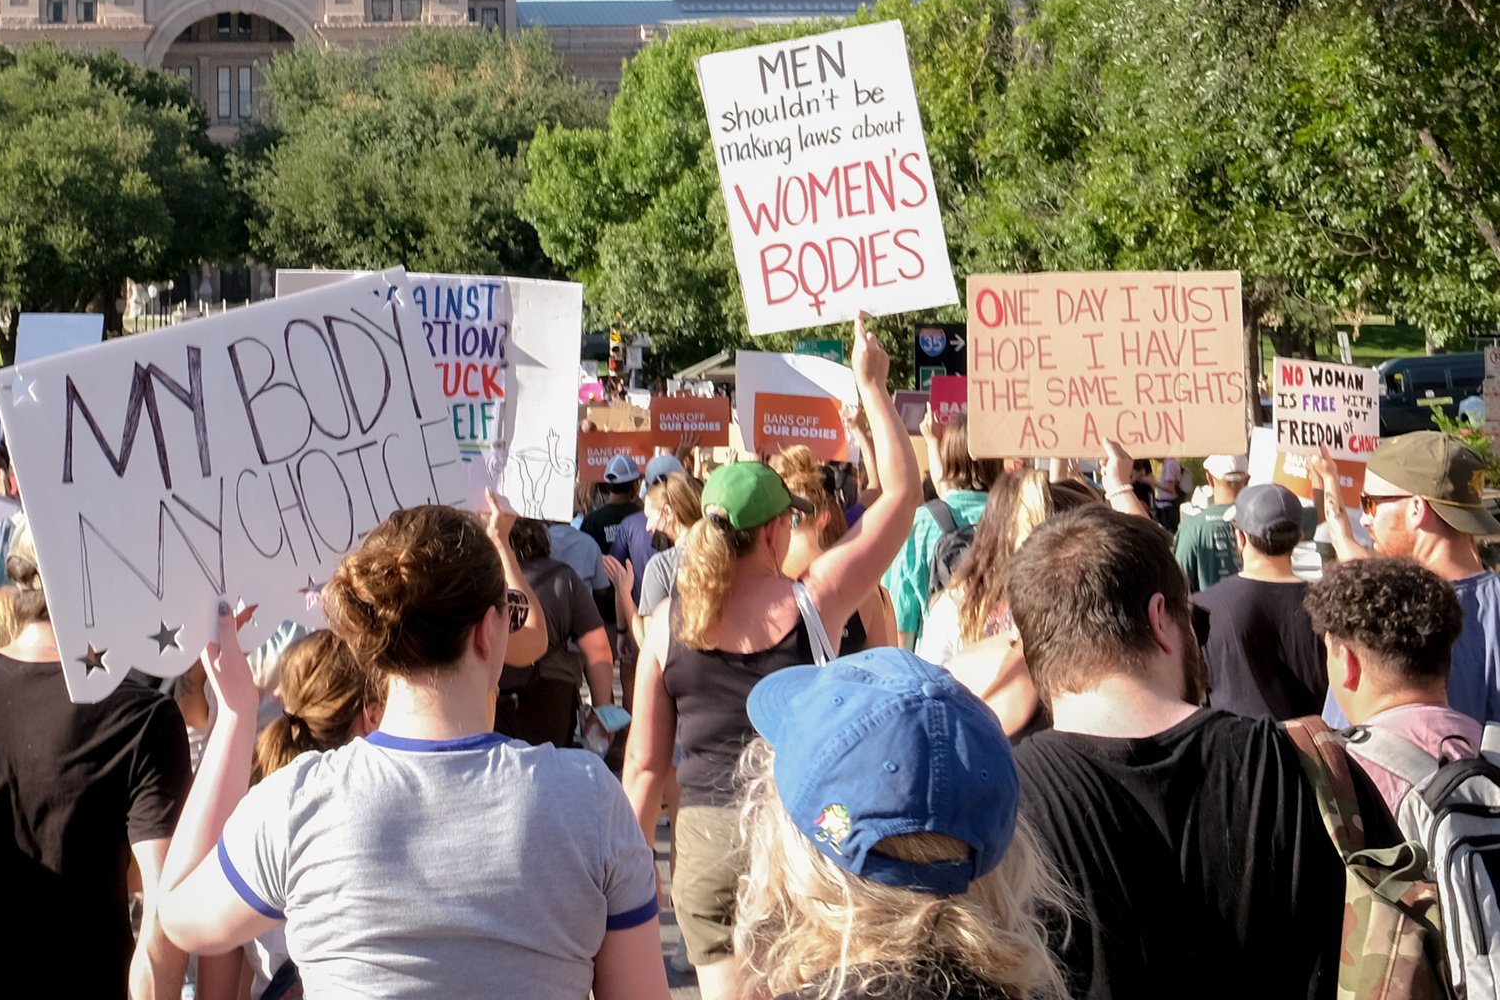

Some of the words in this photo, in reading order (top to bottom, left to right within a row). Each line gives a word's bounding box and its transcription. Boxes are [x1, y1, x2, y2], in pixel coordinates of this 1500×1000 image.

[757, 40, 847, 94] MEN
[720, 88, 840, 133] shouldn't
[853, 79, 885, 107] be
[719, 132, 792, 166] making
[798, 124, 842, 152] laws
[851, 110, 905, 141] about
[733, 147, 928, 236] WOMEN'S
[759, 228, 925, 317] BODIES
[412, 283, 501, 322] AINST
[975, 286, 1042, 329] ONE
[1056, 287, 1108, 325] DAY
[1119, 285, 1141, 323] I
[1152, 284, 1235, 325] JUST
[421, 320, 509, 369] RTION?
[923, 335, 942, 352] 35
[974, 334, 1057, 373] HOPE
[1082, 332, 1105, 370] I
[1120, 327, 1218, 368] HAVE
[62, 344, 212, 490] MY
[227, 302, 422, 465] BODY
[434, 361, 505, 401] UCK
[971, 378, 1034, 412] THE
[1046, 375, 1123, 408] SAME
[1135, 370, 1245, 406] RIGHTS
[1281, 364, 1305, 387] NO
[1308, 366, 1364, 392] WOMAN
[660, 412, 686, 422] BANS
[686, 412, 706, 422] OFF
[763, 412, 794, 425] BANS
[795, 415, 820, 427] OFF
[1277, 393, 1298, 410] IS
[1302, 393, 1337, 413] FREE
[1346, 408, 1369, 423] OUT
[659, 421, 683, 432] OUR
[683, 421, 721, 432] BODIES
[762, 424, 790, 436] OUR
[791, 426, 837, 440] BODIES
[1018, 413, 1059, 450] AS
[1082, 411, 1101, 448] A
[1115, 407, 1186, 446] GUN
[1276, 419, 1344, 451] FREEDOM
[1342, 420, 1354, 434] OF
[587, 447, 613, 457] BANS
[613, 447, 633, 456] OFF
[77, 477, 227, 628] MY
[234, 405, 466, 568] CHOICE
